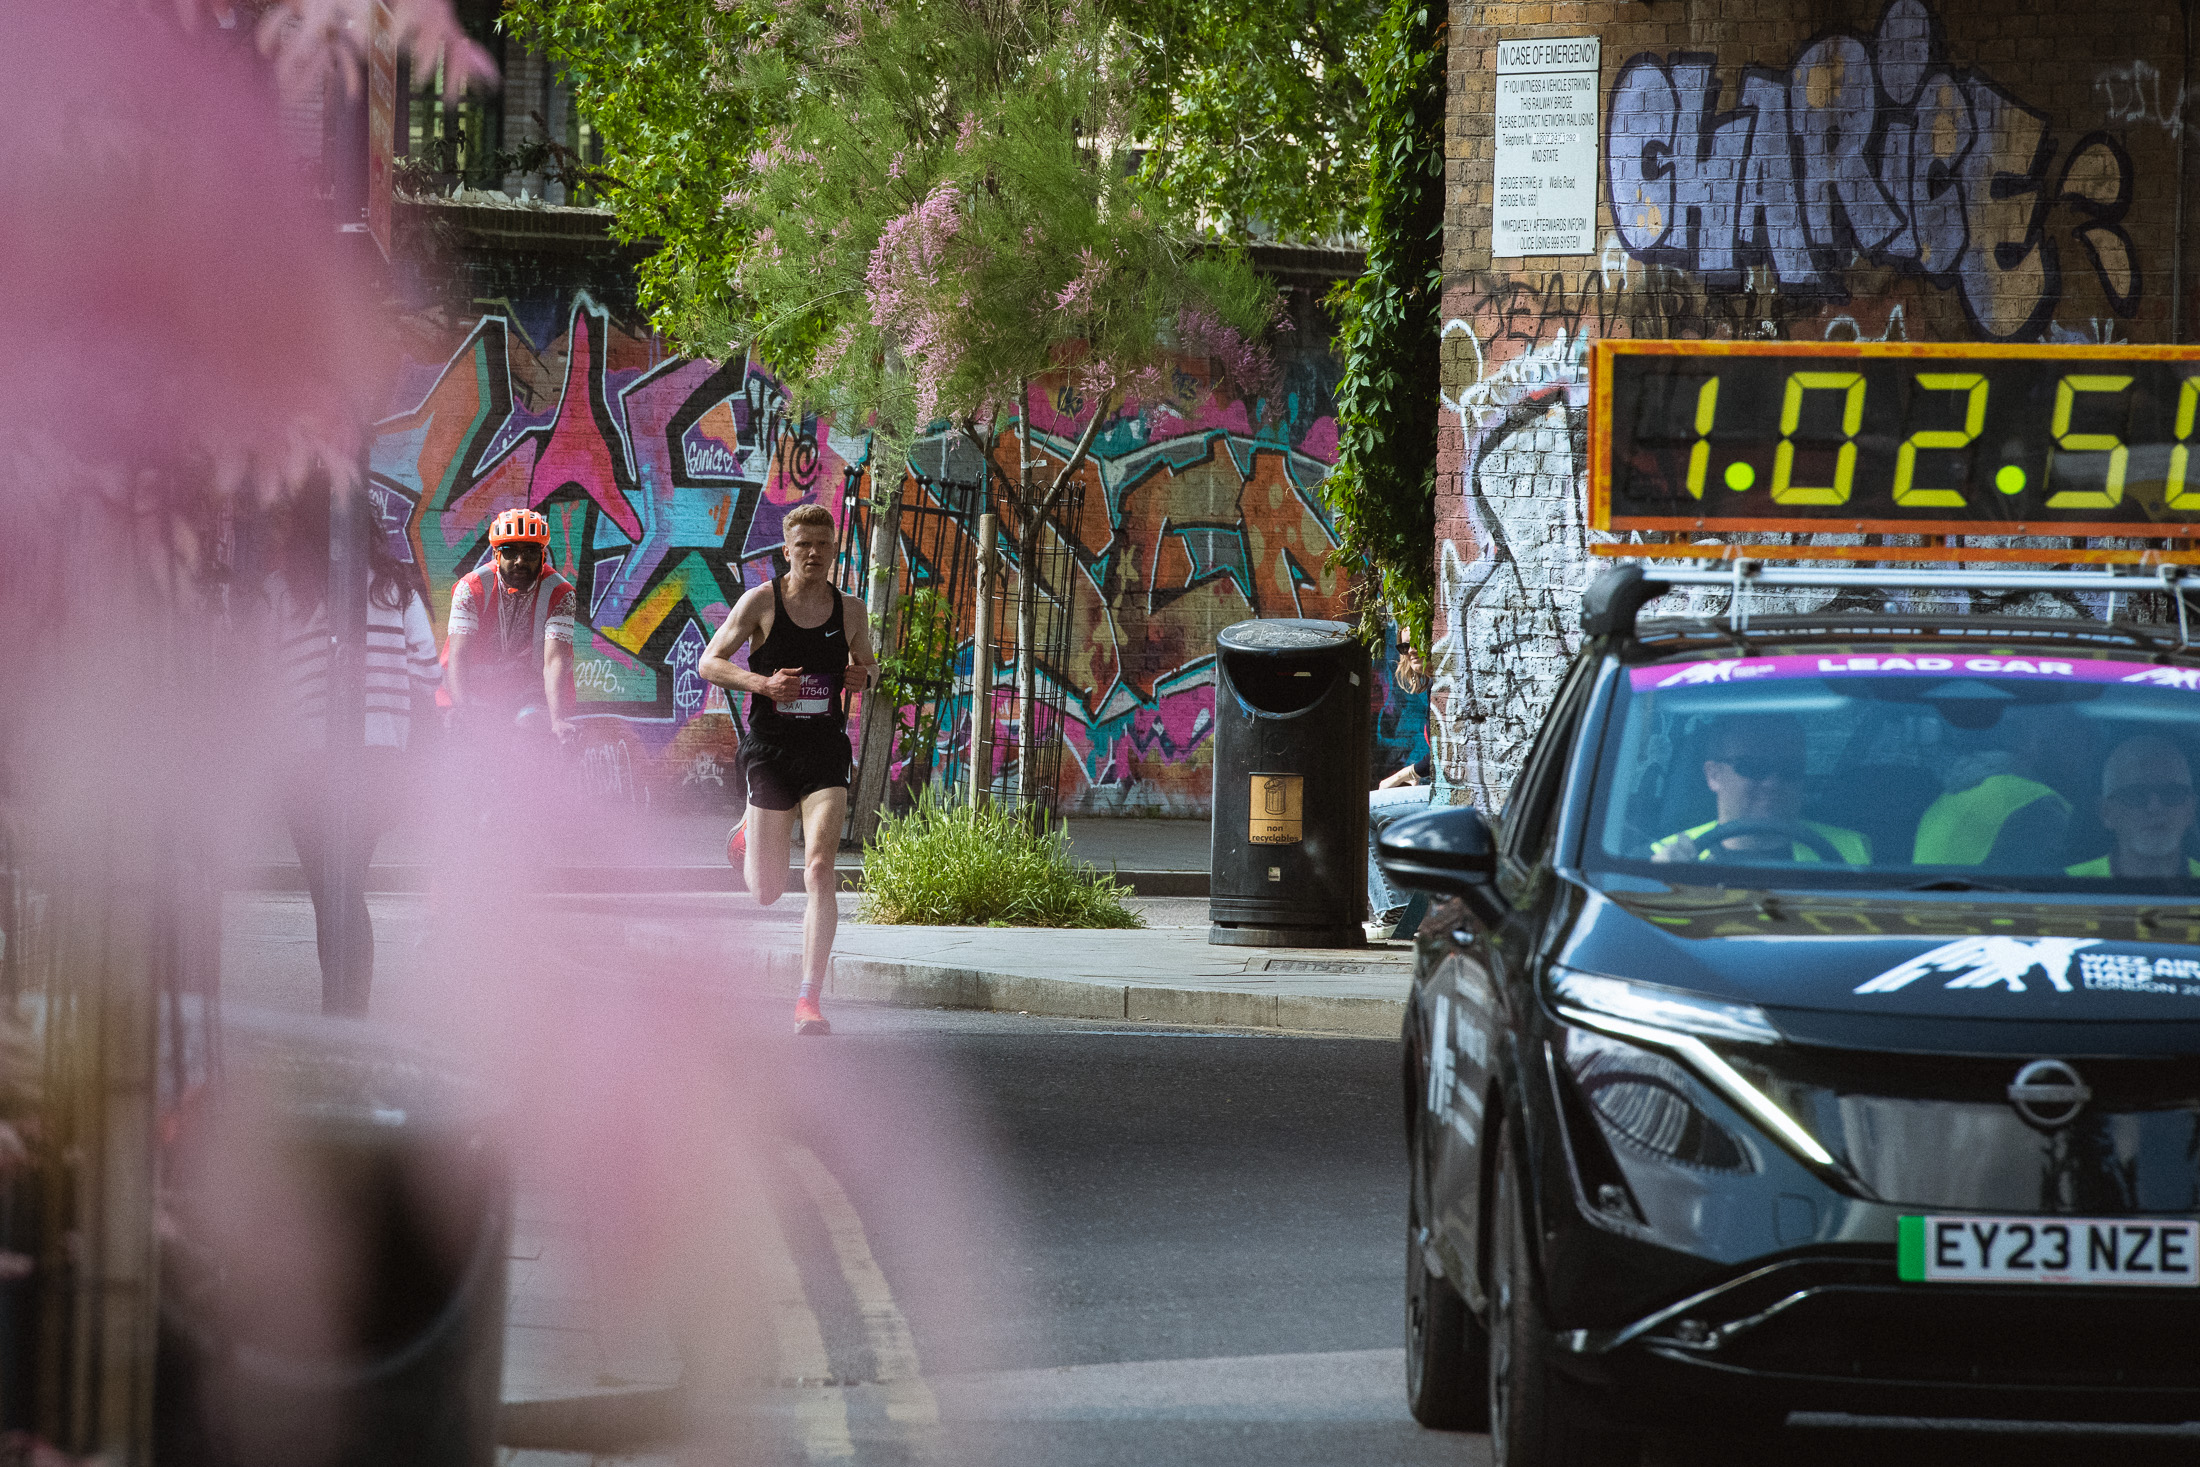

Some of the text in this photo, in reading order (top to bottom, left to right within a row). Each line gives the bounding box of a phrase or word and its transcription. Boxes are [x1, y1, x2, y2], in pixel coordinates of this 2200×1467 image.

[1500, 43, 1597, 66] IN CASE OF EMERGENCY
[1503, 77, 1591, 93] IF YOU WITNESS A VEHICLE STRIKING
[1520, 95, 1573, 110] THIS RAILWAY BRIDGE
[1499, 112, 1595, 128] PLEASE CONTACT NETWORK RAIL USING
[1503, 133, 1525, 149] Telephone
[1536, 134, 1550, 143] 0207
[1551, 134, 1561, 143] 247
[1563, 133, 1577, 142] 1292
[1531, 149, 1559, 163] AND STATE
[1500, 176, 1519, 189] BRIDGE
[1500, 193, 1519, 207] BRIDGE
[1533, 218, 1566, 232] AFTERWARDS
[1568, 217, 1587, 231] INFORM
[1560, 235, 1581, 249] SYSTEM
[1817, 658, 2073, 675] LEAD CAR
[801, 686, 829, 696] 17540
[782, 701, 803, 711] SAM
[1252, 833, 1299, 843] recyclables
[1935, 1221, 2189, 1273] EY23 NZE
